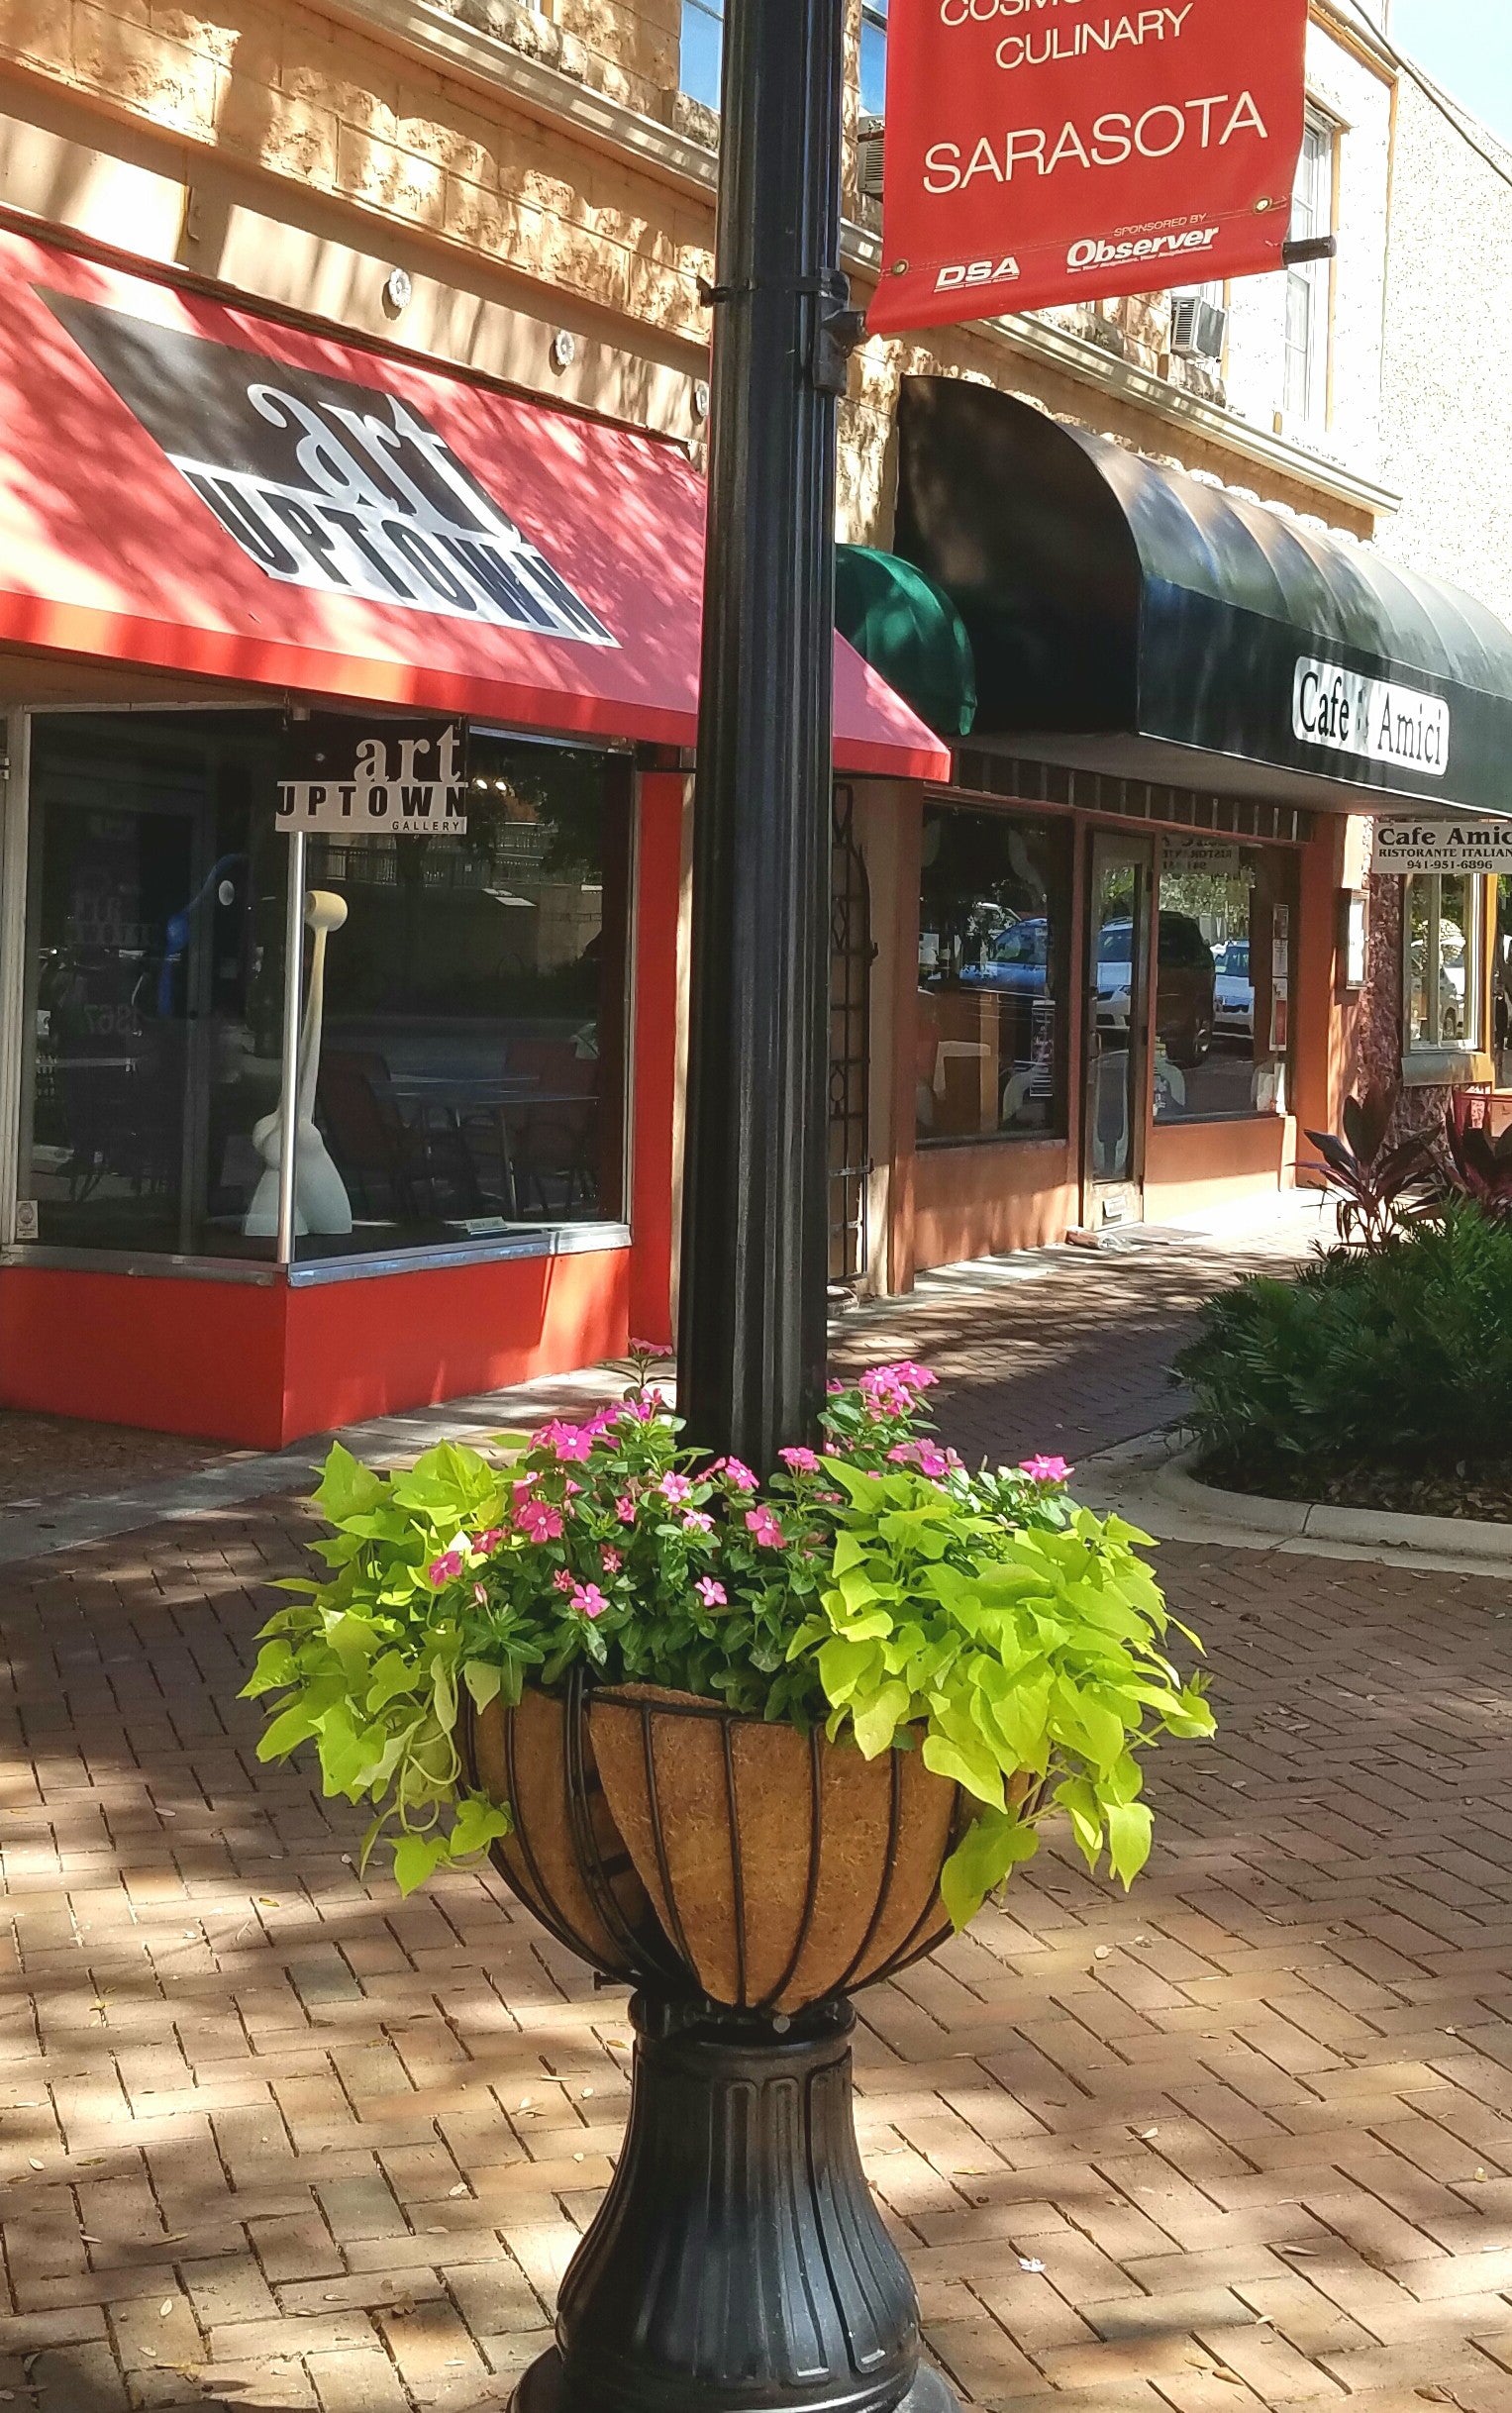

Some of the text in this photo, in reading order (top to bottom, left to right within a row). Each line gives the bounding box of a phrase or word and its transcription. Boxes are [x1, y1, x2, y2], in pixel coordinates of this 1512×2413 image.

[941, 0, 1084, 26] COS
[995, 3, 1194, 69] CULINARY
[923, 91, 1268, 193] SARASOTA
[1114, 213, 1207, 237] SPONSORED BY
[1066, 227, 1220, 266] Observer
[936, 256, 1020, 286] DSA
[248, 383, 526, 544] art
[184, 469, 614, 643] UPTOWN
[1299, 671, 1441, 765] Cafe Amici
[353, 724, 461, 783] art
[275, 785, 467, 817] UPTOWN
[392, 821, 459, 831] GALLERY
[1377, 826, 1512, 846] Cafe Amic
[1378, 849, 1458, 857] RISTORANTE
[1406, 859, 1493, 869] 941-951-6896
